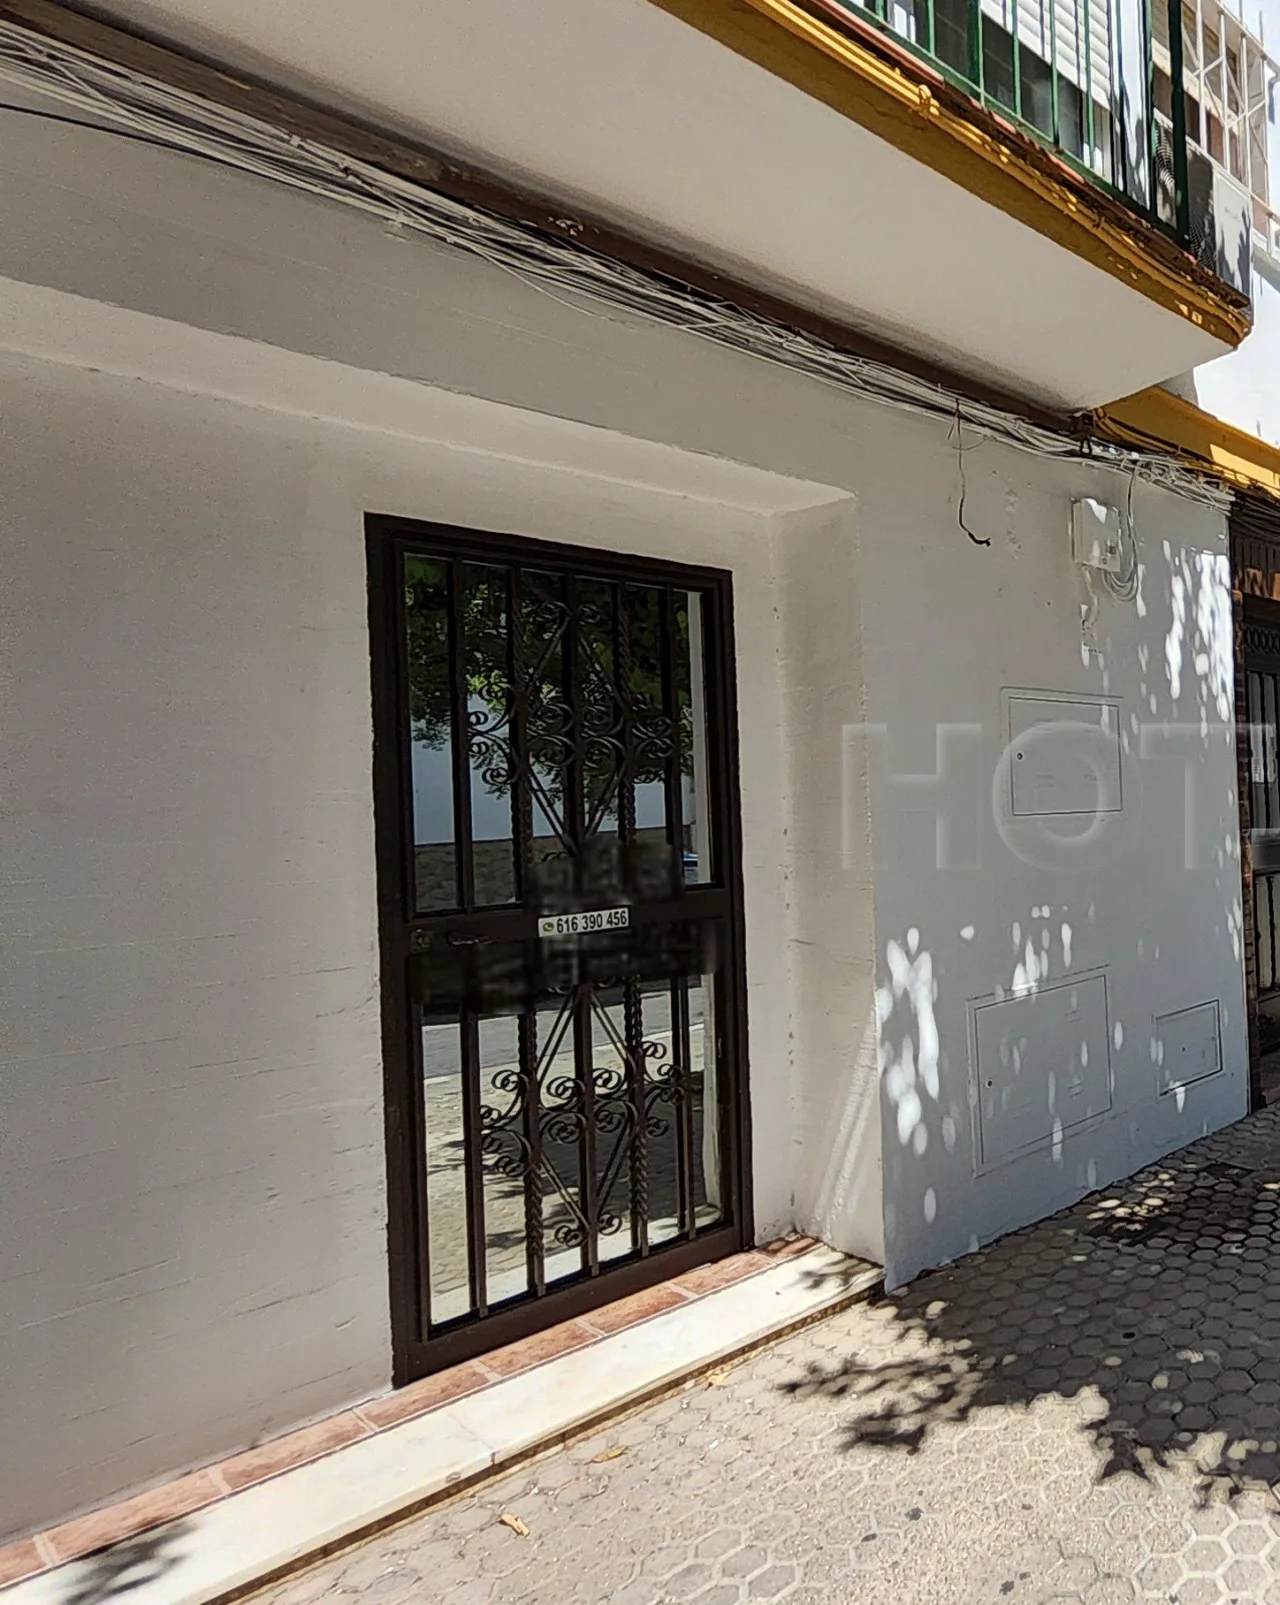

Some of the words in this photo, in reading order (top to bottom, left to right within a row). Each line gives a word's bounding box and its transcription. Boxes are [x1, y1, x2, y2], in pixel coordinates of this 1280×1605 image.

[556, 916, 579, 934] 616
[582, 913, 603, 931] 390
[606, 910, 627, 927] 456
